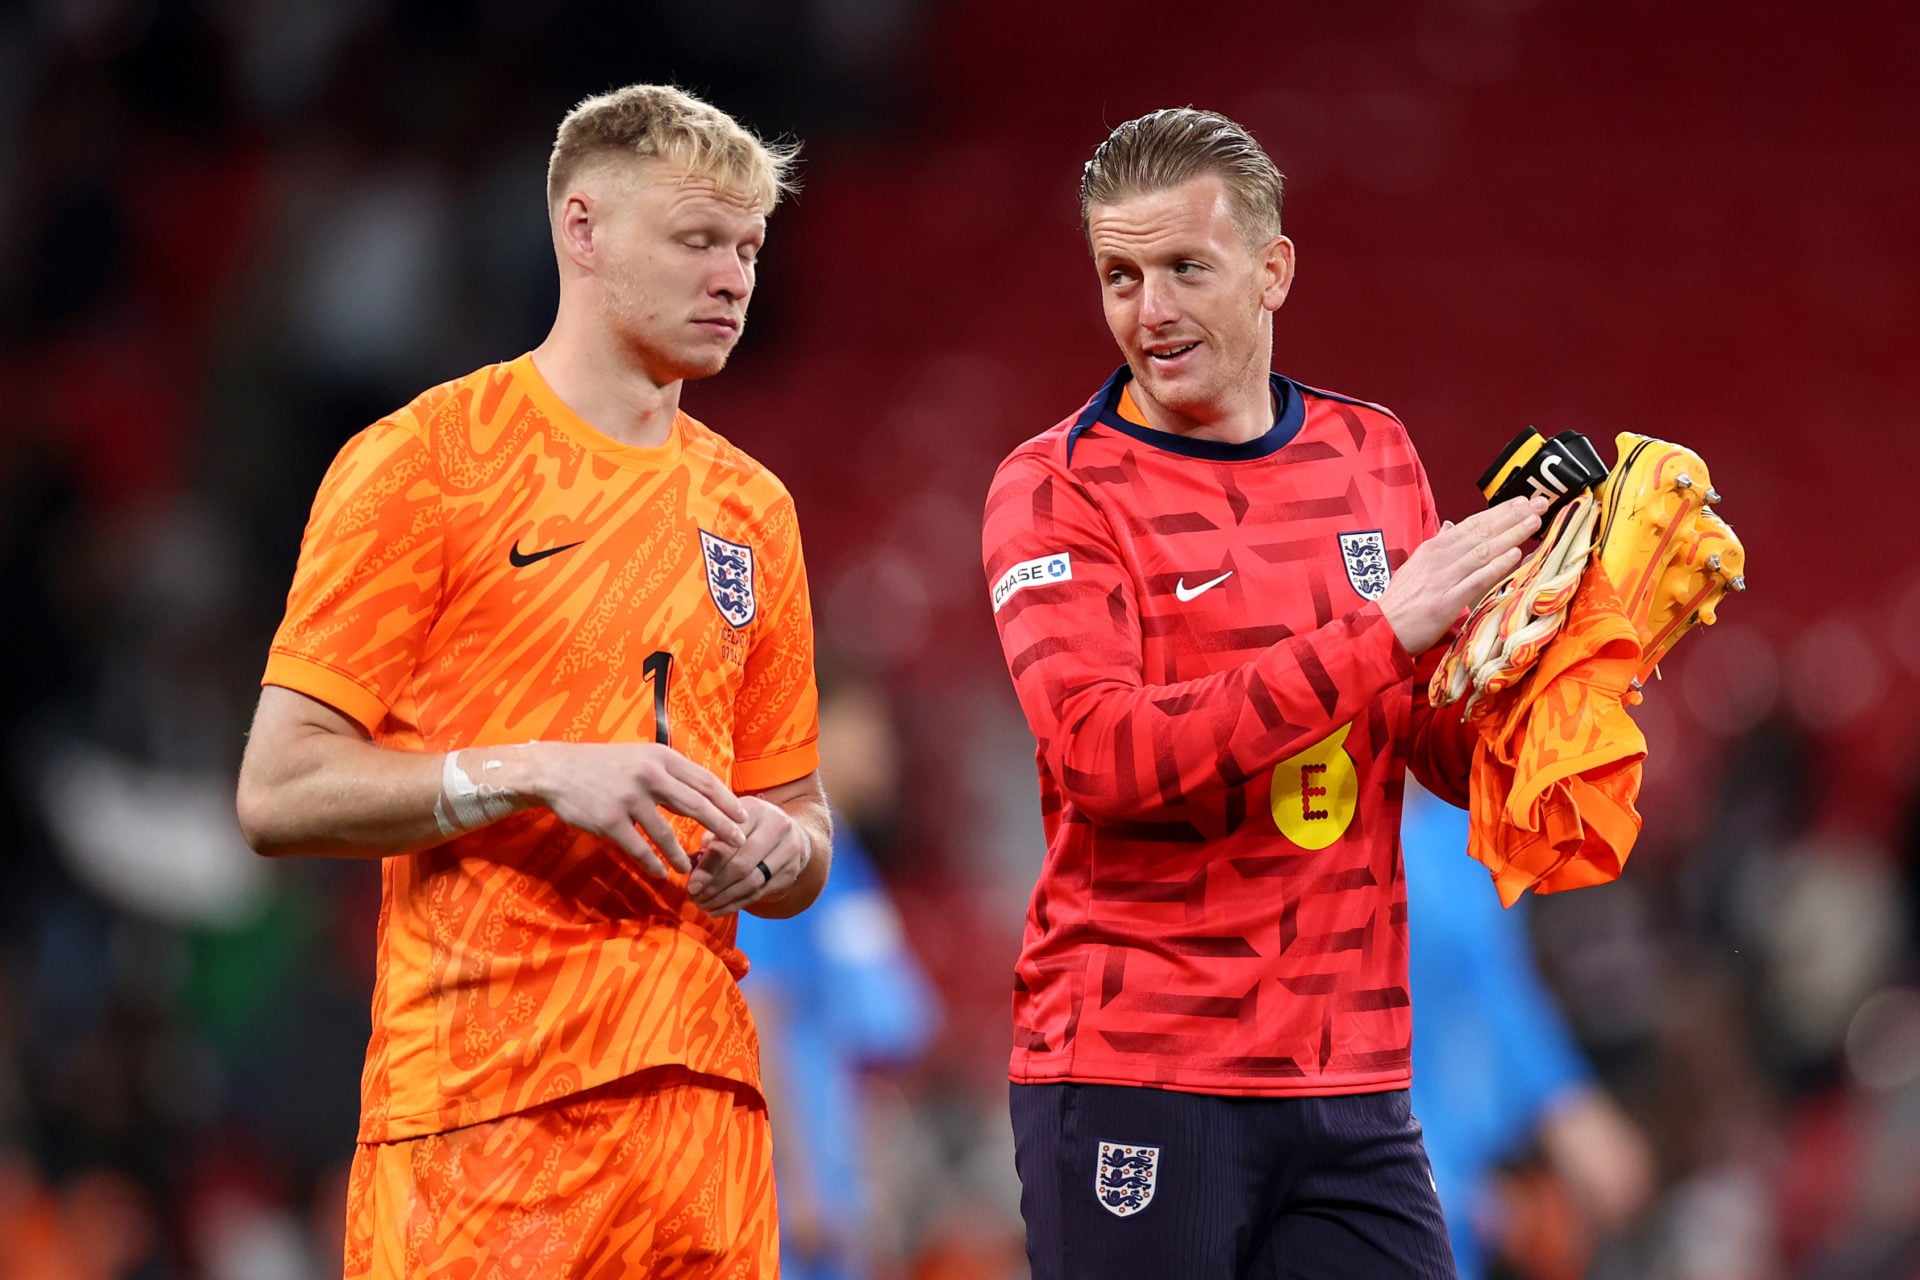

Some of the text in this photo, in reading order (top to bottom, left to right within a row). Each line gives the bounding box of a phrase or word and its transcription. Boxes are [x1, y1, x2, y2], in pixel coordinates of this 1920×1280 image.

[995, 565, 1044, 603] CHASE
[643, 651, 674, 748] 1
[1301, 763, 1328, 820] E
